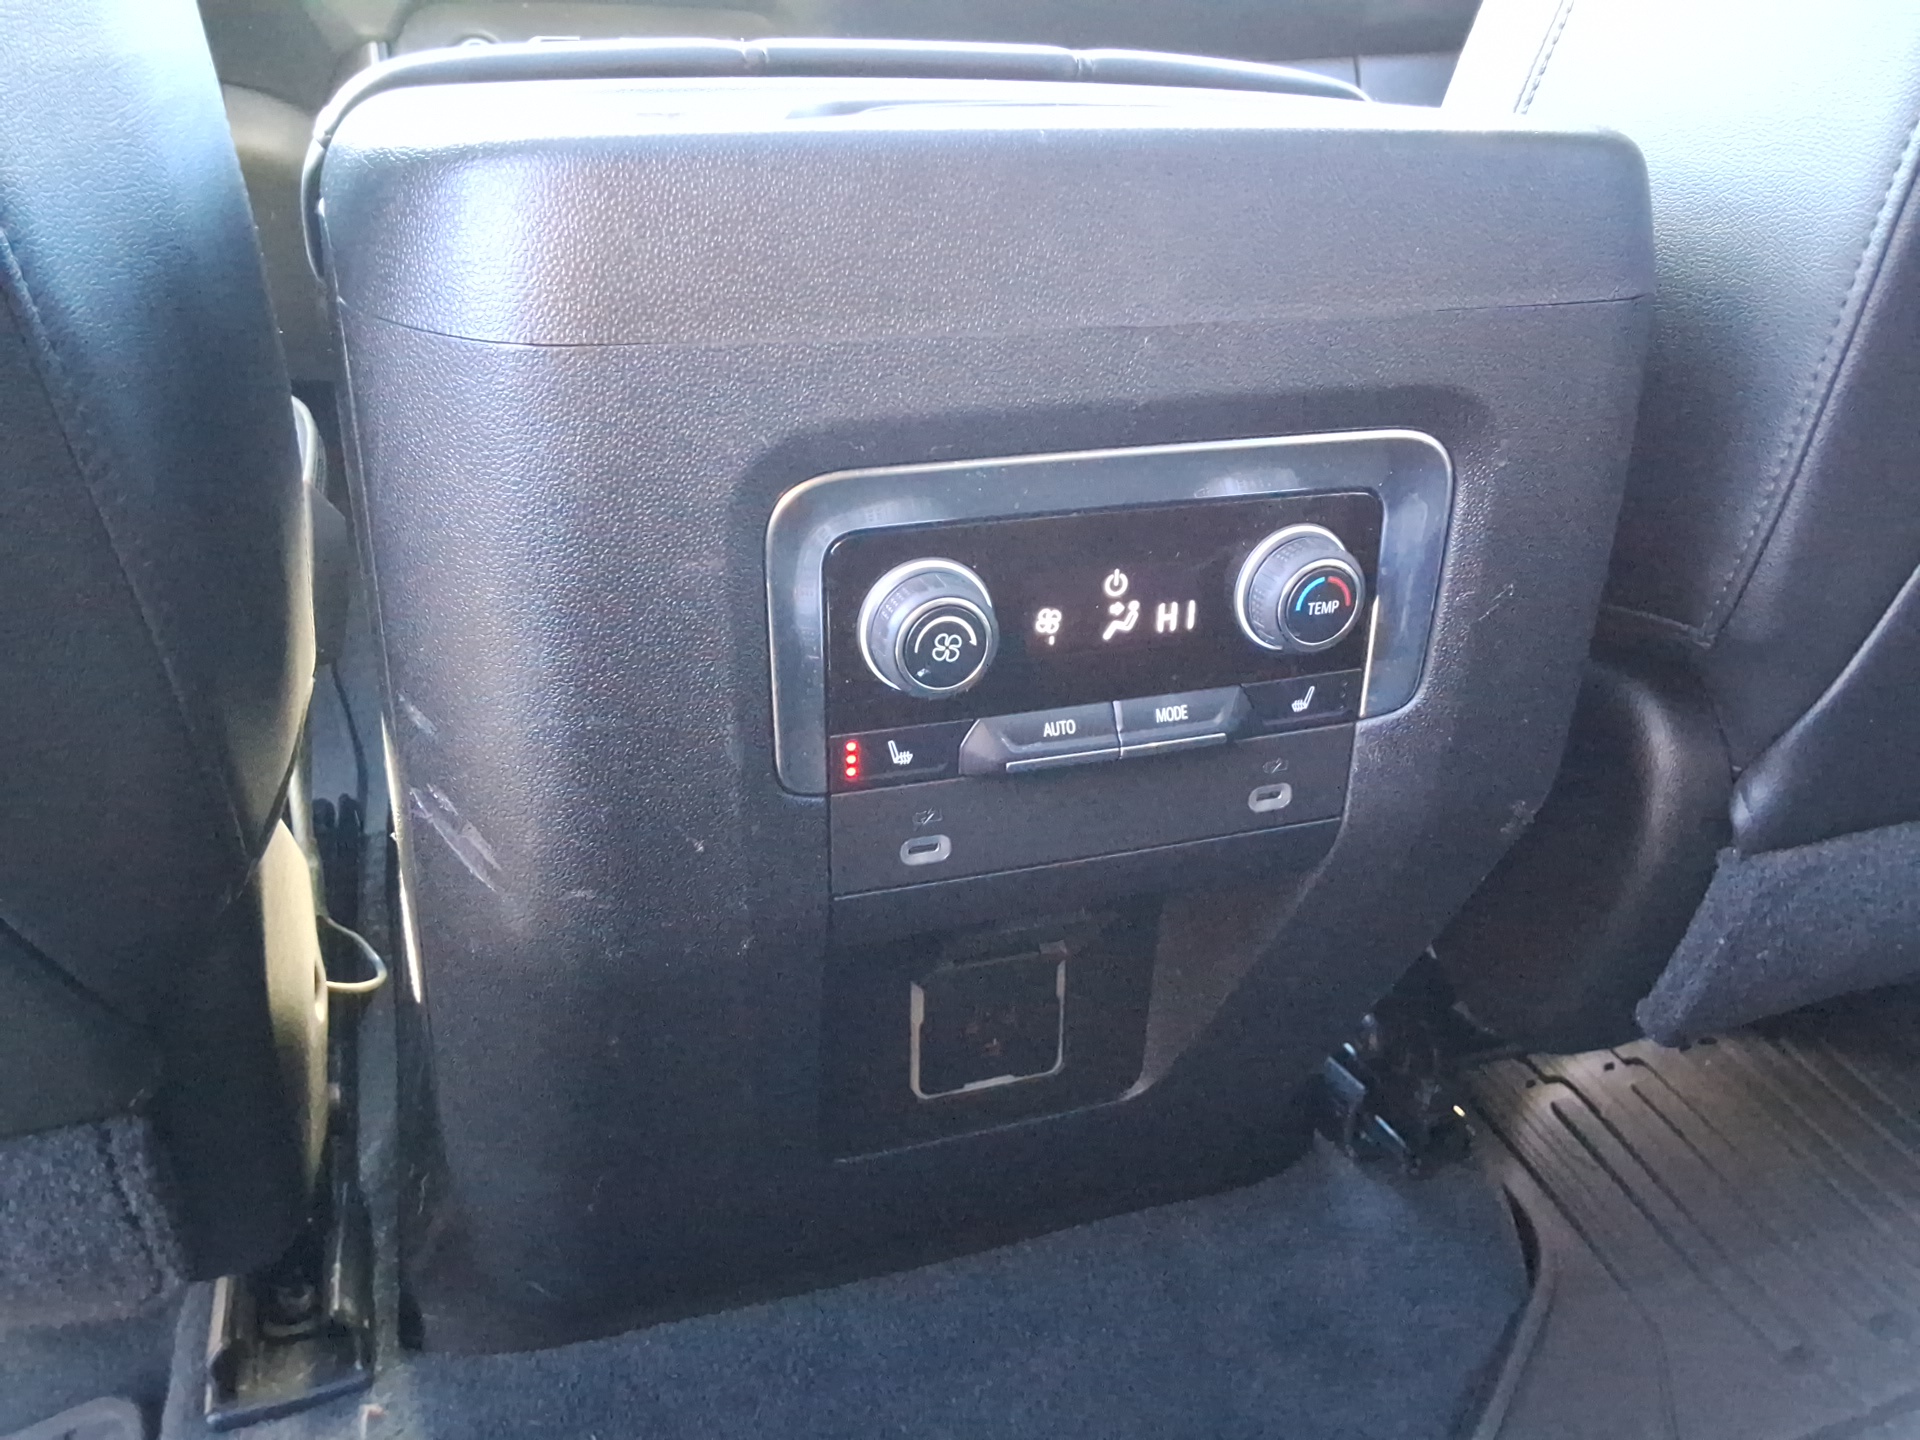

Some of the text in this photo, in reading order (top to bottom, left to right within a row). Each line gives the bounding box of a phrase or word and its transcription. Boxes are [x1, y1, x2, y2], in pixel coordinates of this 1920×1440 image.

[1156, 600, 1196, 633] HI
[1308, 600, 1339, 615] TEMP
[1155, 705, 1188, 723] MODE
[1043, 719, 1076, 737] AUTO
